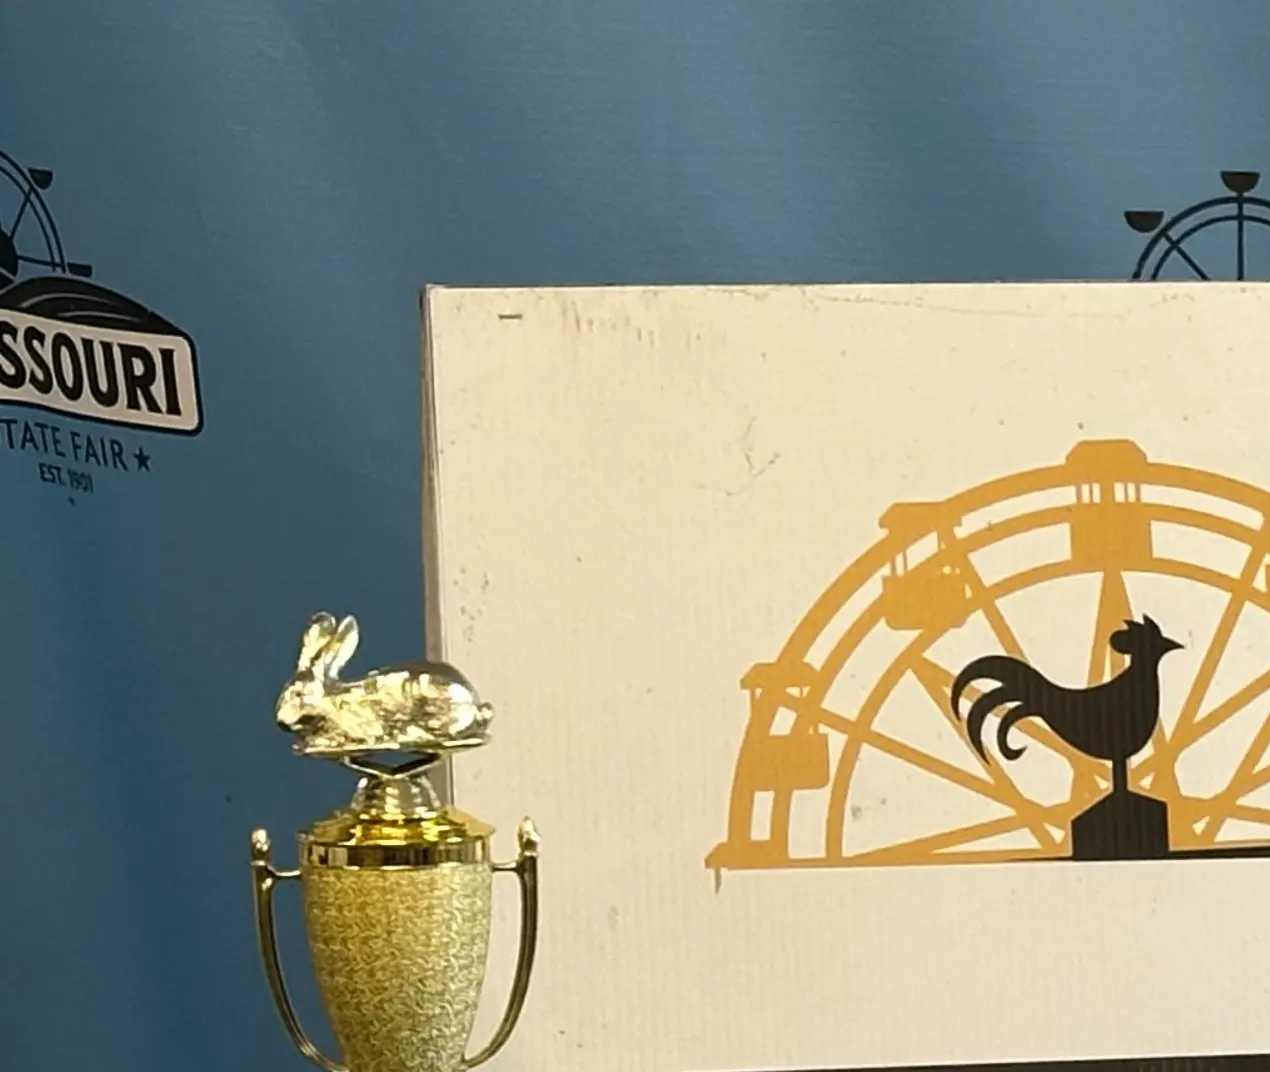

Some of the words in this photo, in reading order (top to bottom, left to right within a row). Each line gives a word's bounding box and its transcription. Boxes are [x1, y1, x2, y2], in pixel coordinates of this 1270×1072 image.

[0, 320, 182, 416] SSOURI
[0, 418, 66, 458] TATE
[70, 431, 128, 473] FAIR
